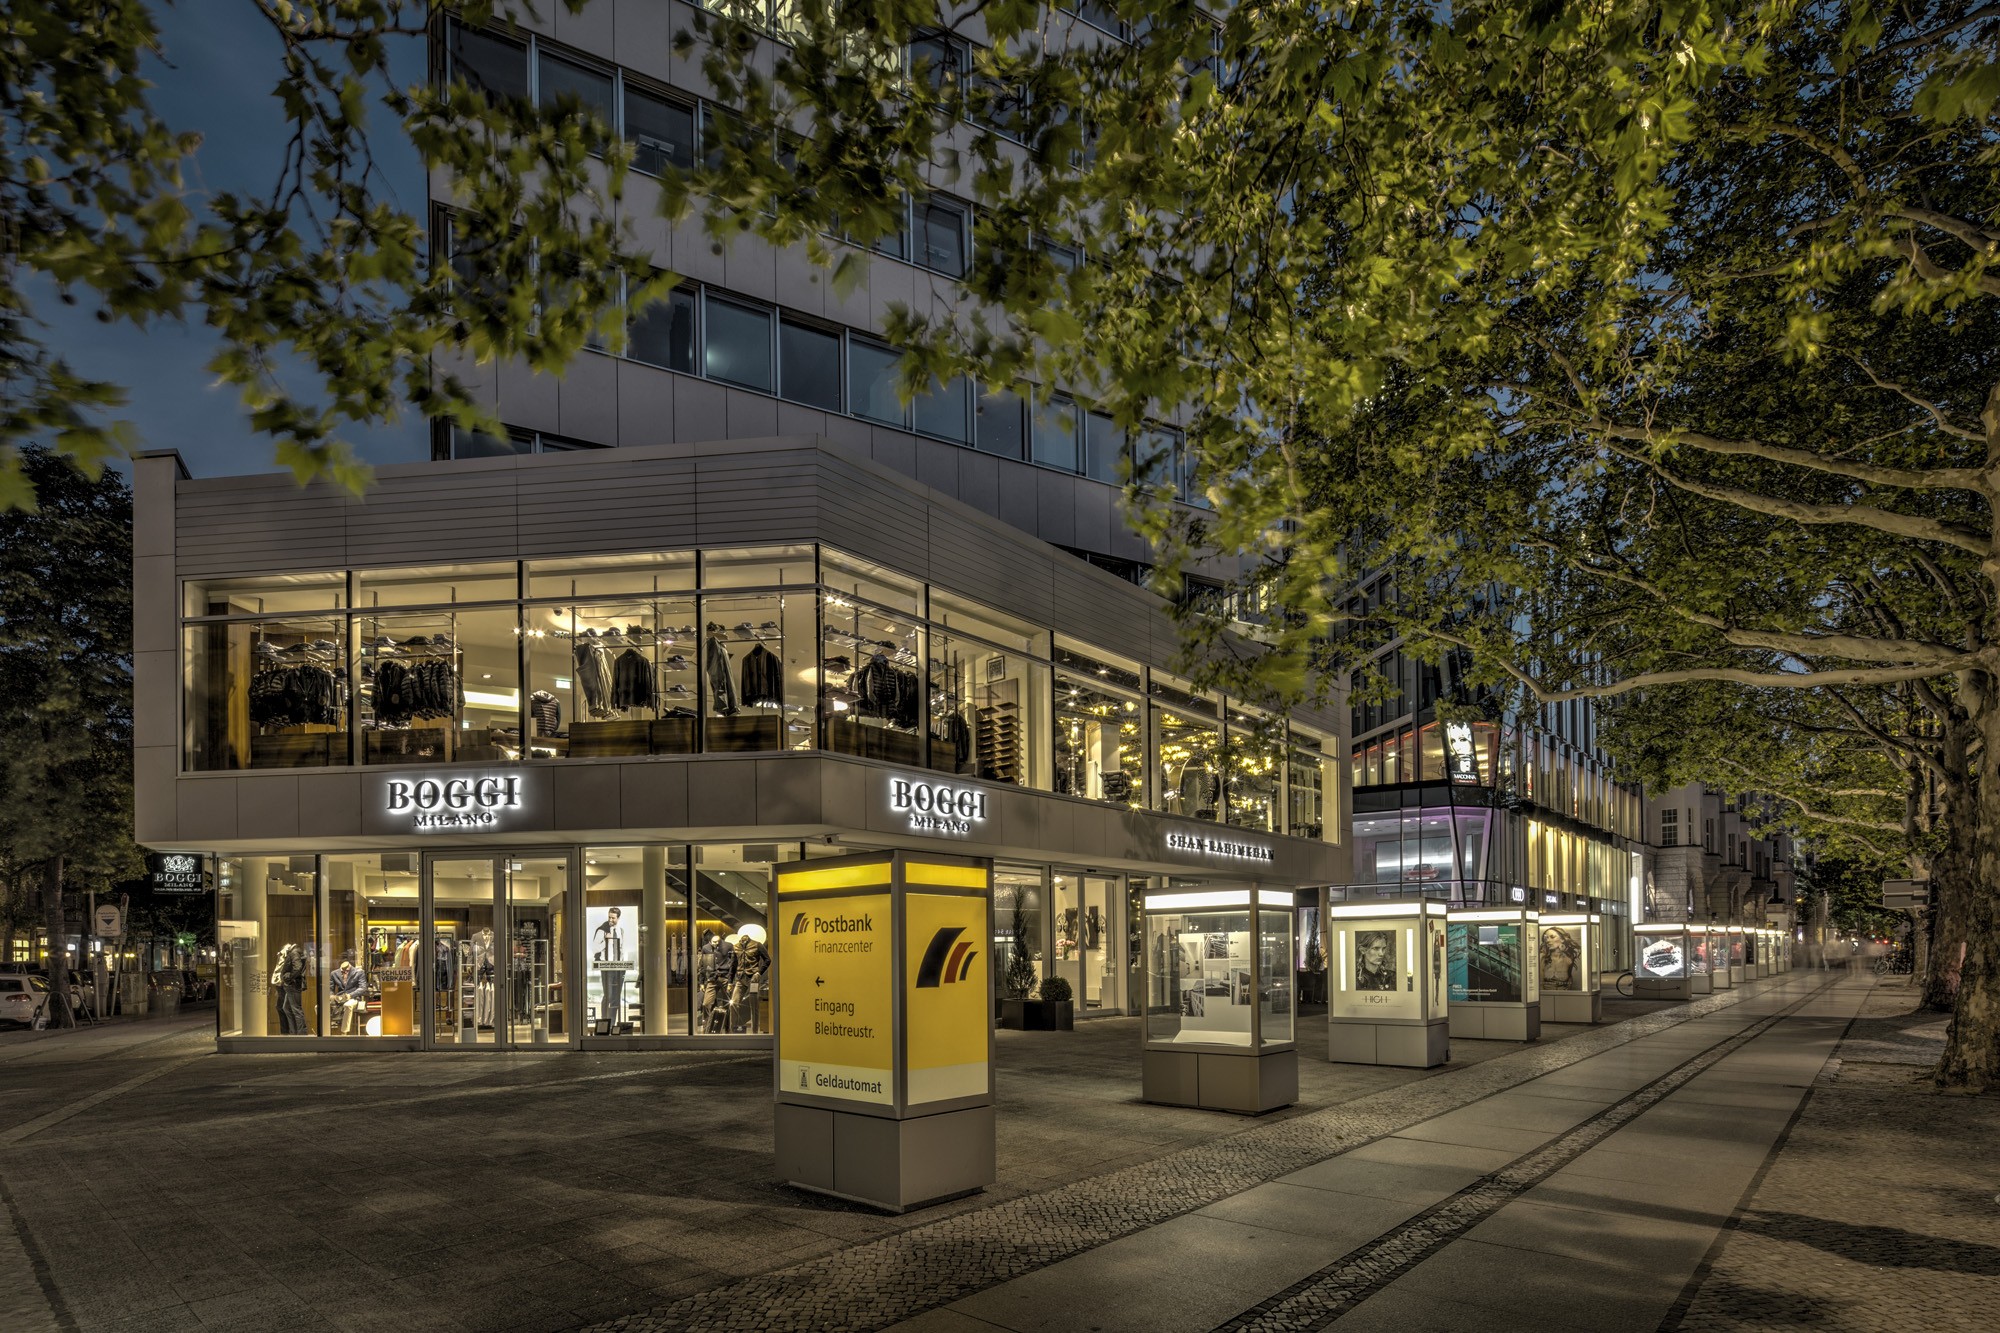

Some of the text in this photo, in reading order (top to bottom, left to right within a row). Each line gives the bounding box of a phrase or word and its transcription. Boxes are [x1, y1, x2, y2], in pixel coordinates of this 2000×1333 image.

[386, 777, 518, 810] BOGGI
[893, 780, 987, 819] BOGGI
[413, 812, 492, 827] MILANO
[914, 816, 971, 833] MILANO
[1169, 834, 1204, 851] SHAN
[154, 873, 202, 882] BOGGI
[814, 913, 873, 934] Postbank
[814, 940, 873, 954] Finanzcenter
[814, 998, 855, 1017] Eingang
[814, 1021, 875, 1039] Bleibtreustr.
[815, 1073, 882, 1094] Geldautomat
